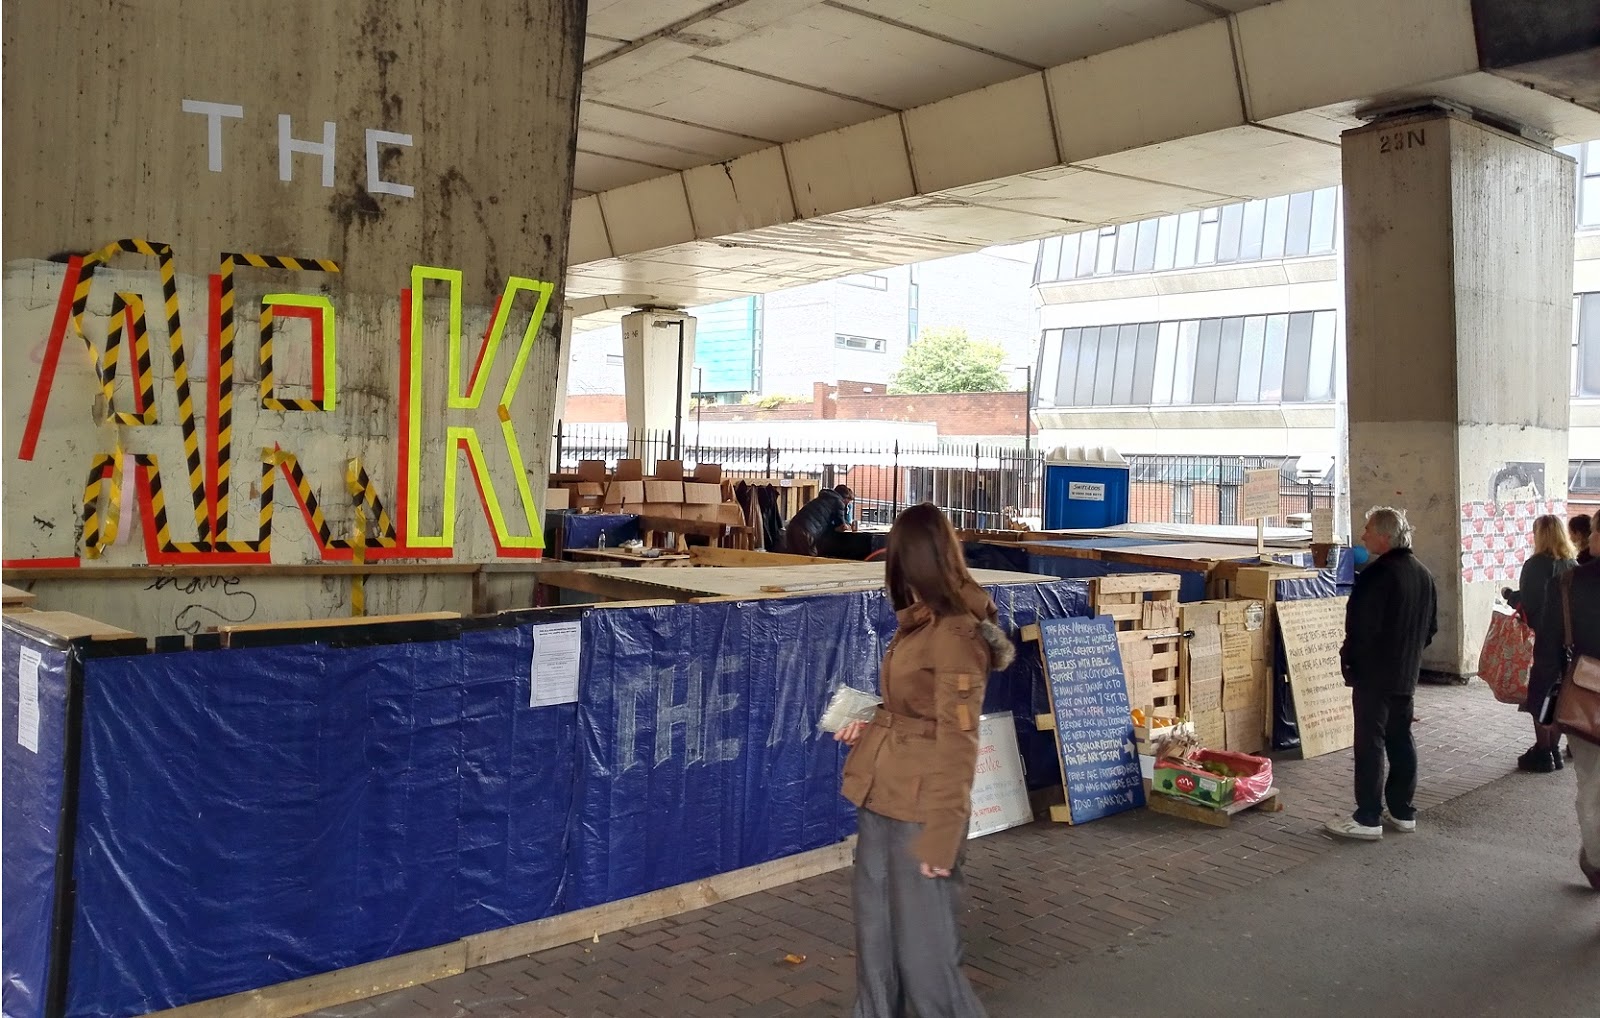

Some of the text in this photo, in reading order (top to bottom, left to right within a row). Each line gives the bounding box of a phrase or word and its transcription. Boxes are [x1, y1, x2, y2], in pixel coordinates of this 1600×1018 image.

[18, 238, 556, 566] ARK
[1058, 623, 1072, 636] ARK
[1060, 635, 1090, 646] SELF-BUILT
[1092, 633, 1116, 645] HOMELESS
[1073, 645, 1096, 656] CREATED
[1096, 645, 1104, 654] BY
[1105, 642, 1116, 652] THE
[1049, 656, 1111, 672] HOMELESS WITH PUBLIC
[1089, 668, 1100, 679] CITY
[1101, 665, 1123, 678] COUNCIL
[1073, 683, 1084, 693] ARE
[1084, 681, 1103, 692] TAKING
[1104, 680, 1112, 690] US
[1111, 679, 1121, 688] TO
[1055, 692, 1127, 707] COURT ON MON 7 SEPT TO
[1058, 707, 1074, 719] TEAR
[1073, 707, 1086, 717] THIS
[1105, 705, 1115, 714] AND
[1115, 704, 1130, 715] FORCE
[1083, 717, 1097, 727] BACK
[1061, 730, 1072, 742] WE
[1072, 729, 1086, 740] NEED
[1086, 729, 1102, 740] YOUR
[1076, 741, 1089, 753] SIGN
[1089, 740, 1100, 750] OUR
[1100, 738, 1123, 750] PETITION
[1065, 749, 1121, 766] FOR THE ARK TO STAY
[1087, 769, 1098, 780] ARE
[1126, 762, 1139, 774] HERE
[1085, 781, 1099, 793] HAVE
[1100, 778, 1126, 791] NOWHERE
[1126, 776, 1140, 787] ELSE
[1095, 795, 1115, 809] THANK
[1114, 794, 1127, 805] YOU
